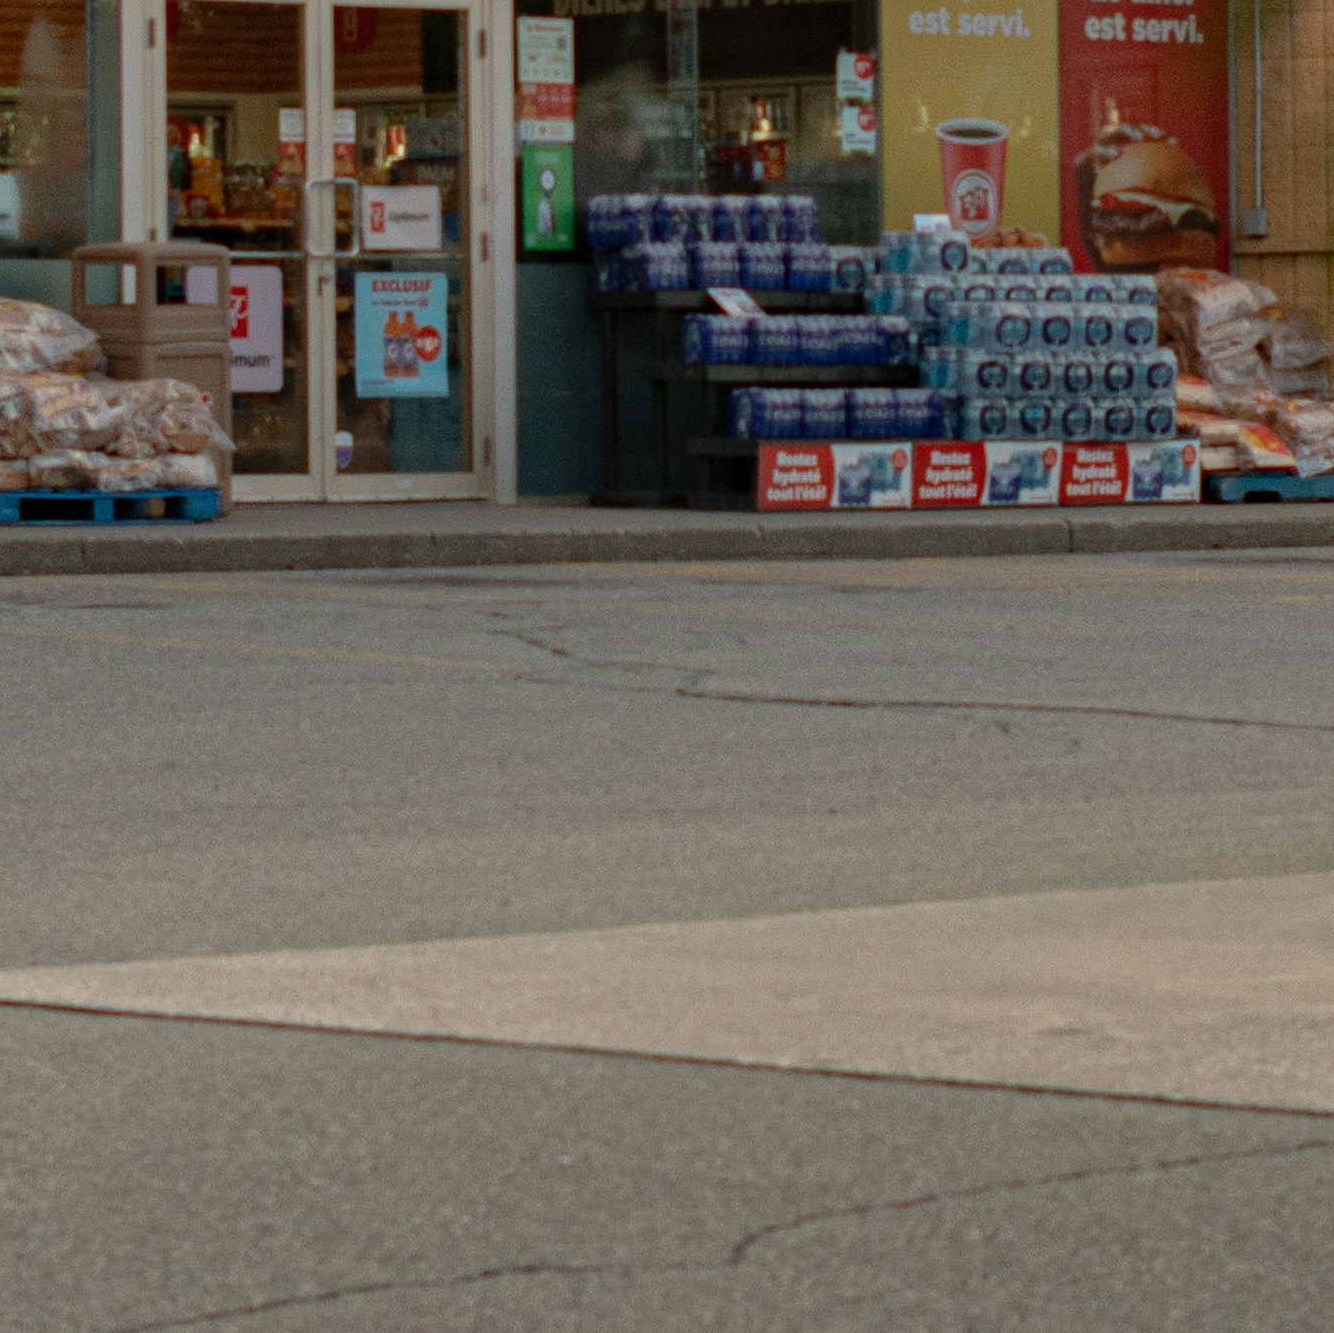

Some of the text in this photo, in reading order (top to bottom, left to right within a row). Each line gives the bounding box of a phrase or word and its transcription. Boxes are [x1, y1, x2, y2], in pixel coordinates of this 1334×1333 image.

[908, 8, 1032, 39] est servi.
[1084, 13, 1204, 45] est servi.
